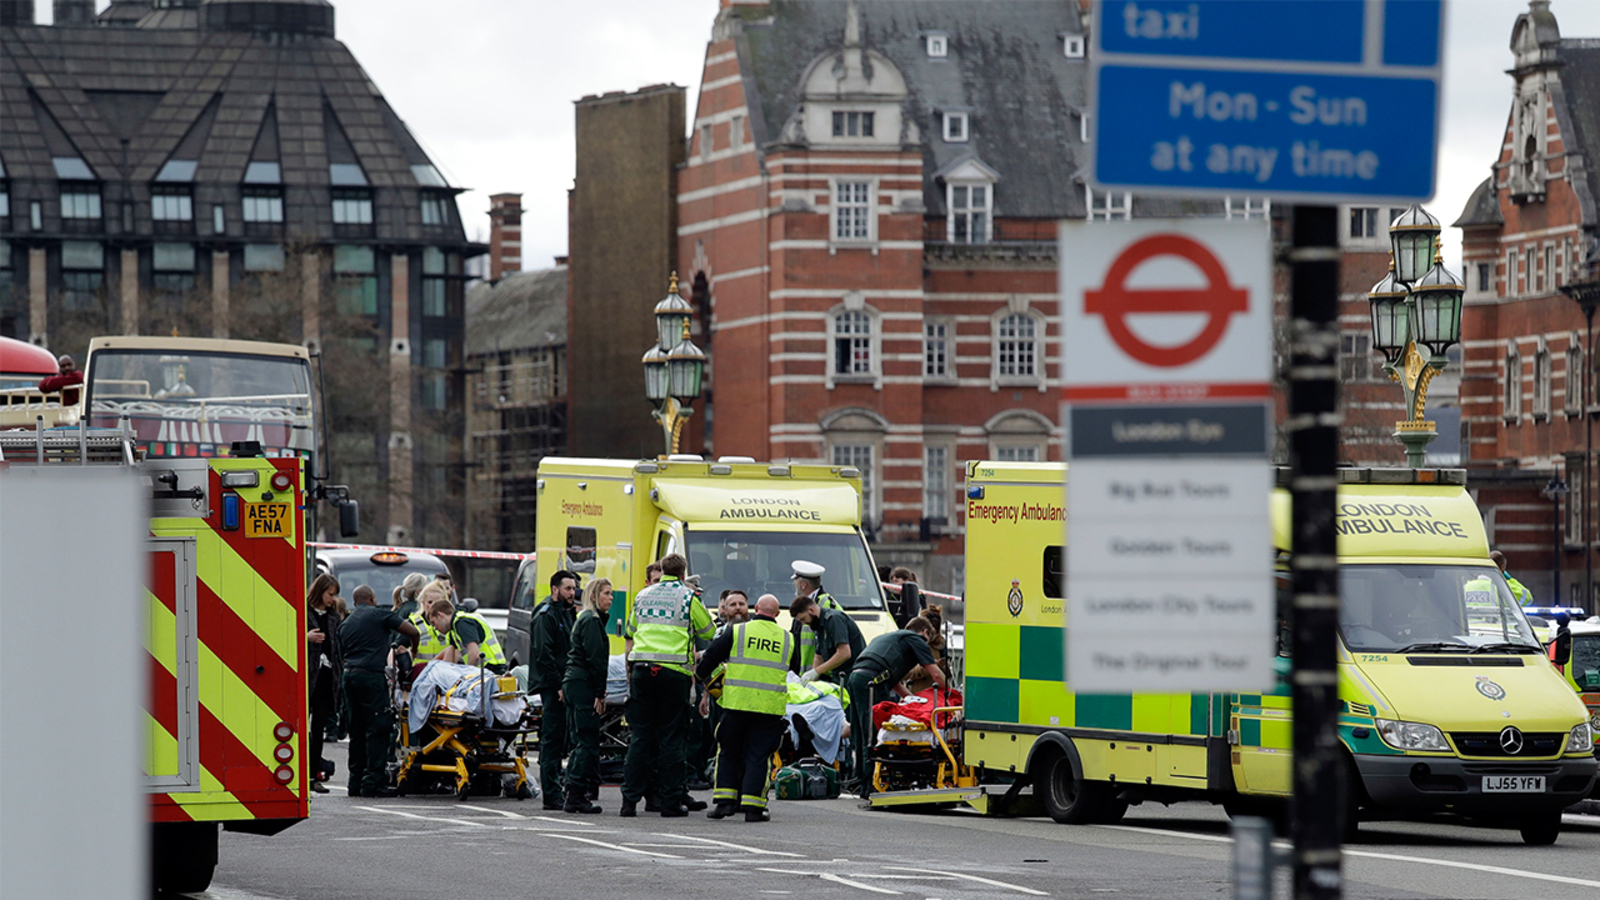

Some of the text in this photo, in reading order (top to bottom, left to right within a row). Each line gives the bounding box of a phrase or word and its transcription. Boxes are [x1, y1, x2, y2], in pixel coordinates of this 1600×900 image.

[1123, 2, 1199, 39] taxi
[1168, 81, 1258, 121] Mon
[1288, 85, 1367, 126] Sun
[1151, 136, 1379, 183] at any time
[1111, 418, 1226, 443] London Eye
[980, 469, 995, 477] 7254
[1110, 479, 1230, 501] Big Bus Tours
[249, 504, 287, 518] AE57
[562, 499, 603, 519] Emergency Ambulance
[731, 498, 801, 506] LONDON
[720, 508, 821, 521] AMBULANCE
[968, 501, 1068, 524] Emergency Ambulanc
[254, 520, 282, 533] FNA
[1335, 519, 1468, 538] MBULANCE
[1110, 536, 1232, 554] Golden Tours
[641, 600, 675, 608] CLEARING
[1041, 605, 1062, 614] London
[1086, 596, 1153, 613] London
[1159, 594, 1198, 617] City
[1205, 594, 1253, 612] Tours
[748, 636, 781, 654] FIRE
[1093, 652, 1247, 673] The Original Tour
[1487, 777, 1541, 790] LJ55 YFW
